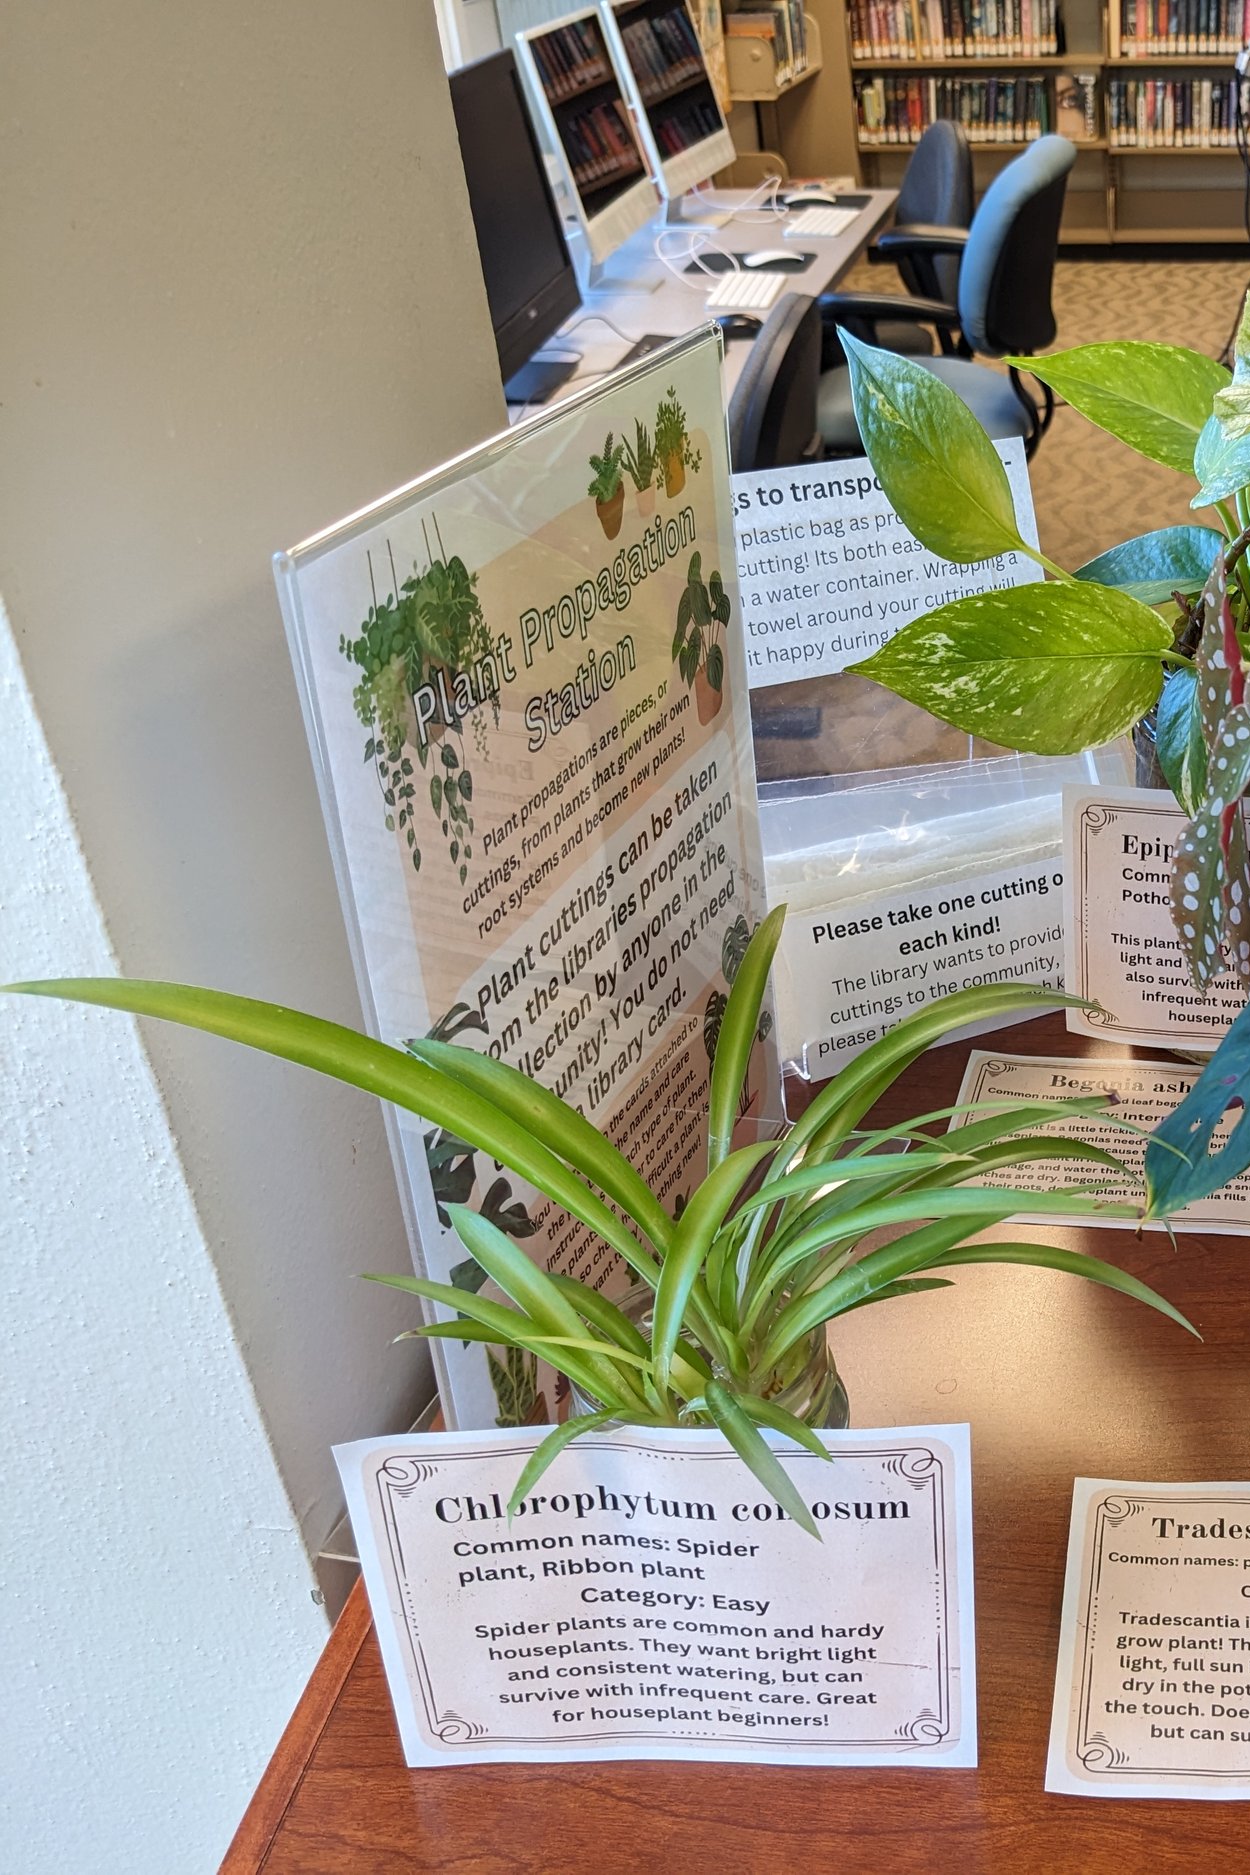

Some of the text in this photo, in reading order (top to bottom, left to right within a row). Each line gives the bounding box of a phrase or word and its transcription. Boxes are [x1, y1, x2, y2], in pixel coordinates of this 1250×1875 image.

[740, 516, 870, 552] plastic bag as
[814, 540, 887, 567] Its both
[751, 568, 919, 606] a water container.
[412, 505, 697, 748] Plant Propagation
[747, 597, 920, 637] towel around your
[747, 628, 889, 667] it happy during
[524, 634, 637, 753] Station
[482, 679, 669, 856] Plant propagations are pieces, or
[463, 693, 690, 914] cuttings, from plants that grow their own
[478, 726, 686, 940] root systems and become new plants!
[477, 760, 718, 1020] Plant cuttings can be taken
[812, 875, 1049, 944] Please take one cutting
[899, 915, 1001, 956] each kind!
[1110, 932, 1182, 951] This plant
[831, 943, 1005, 996] The library wants to
[1120, 951, 1182, 968] light and
[1142, 989, 1218, 1007] infrequent
[1048, 1074, 1145, 1092] Begonia
[1037, 1164, 1120, 1175] and water the
[453, 1534, 760, 1558] Common names: Spider
[1108, 1552, 1179, 1566] Common
[1184, 1557, 1239, 1567] names:
[458, 1555, 706, 1588] plant, Ribbon plant
[580, 1587, 770, 1616] Category: Easy
[552, 1706, 829, 1727] for houseplant beginners!
[1150, 1724, 1185, 1739] but
[1190, 1729, 1224, 1741] can
